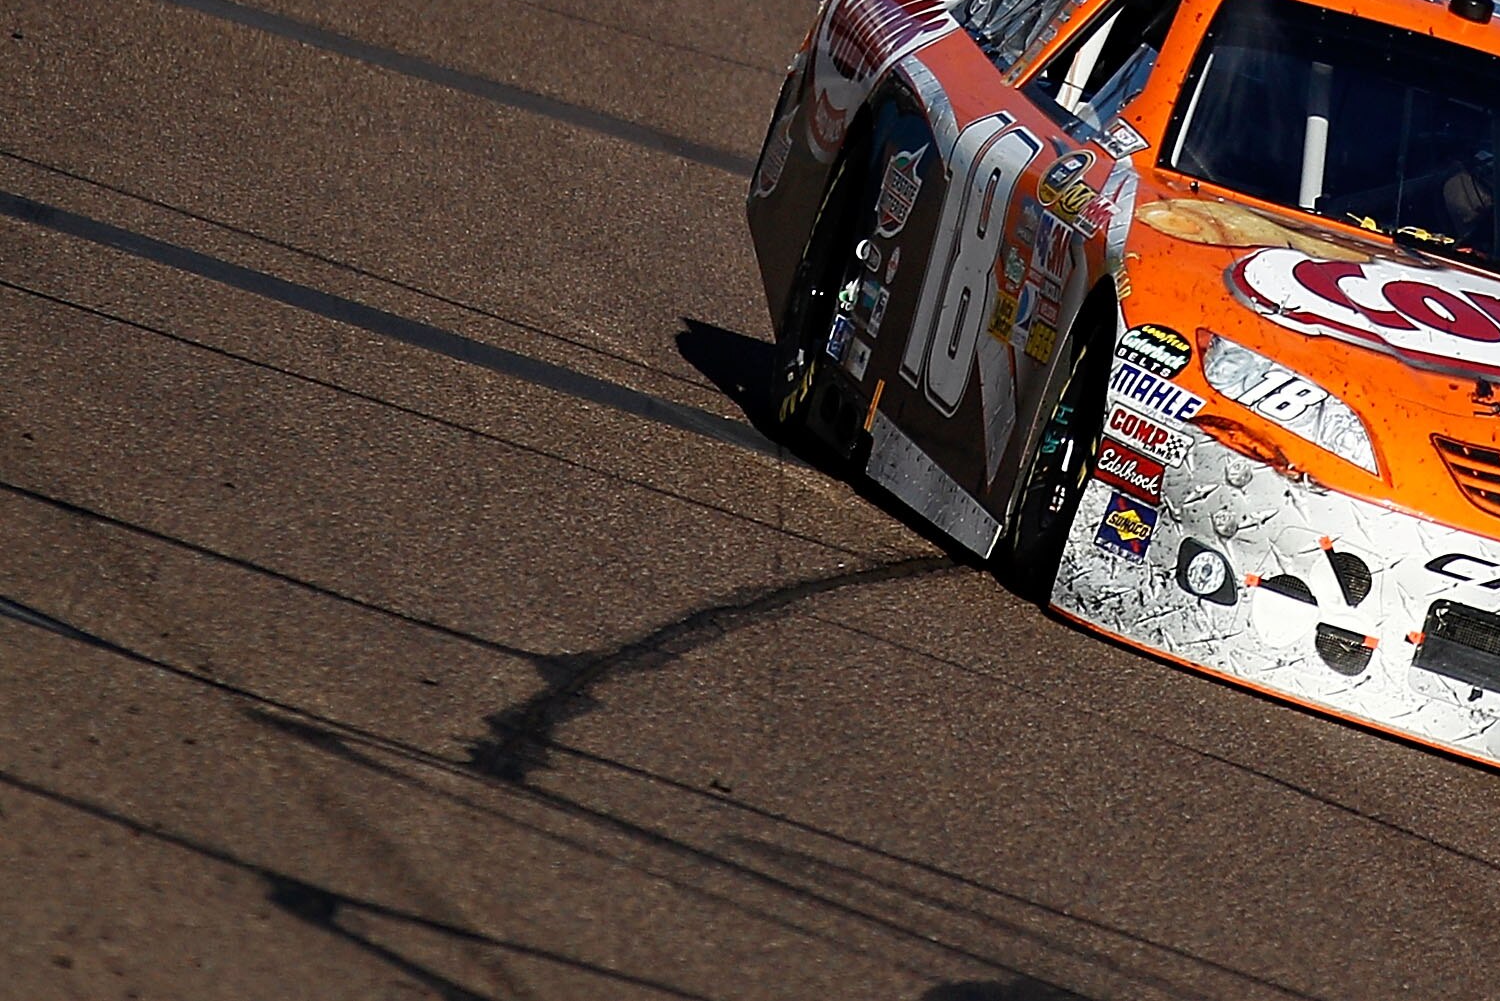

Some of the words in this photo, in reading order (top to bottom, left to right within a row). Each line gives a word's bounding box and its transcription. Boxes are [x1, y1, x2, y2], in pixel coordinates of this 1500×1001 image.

[899, 110, 1044, 418] 18
[1118, 347, 1171, 378] BELTS
[1121, 329, 1188, 369] Gatorback
[1111, 363, 1203, 422] MAHLE
[1235, 369, 1330, 422] 18
[1109, 408, 1169, 446] COMP
[1097, 448, 1159, 496] Edelbrock
[1107, 512, 1149, 539] SUNOCO
